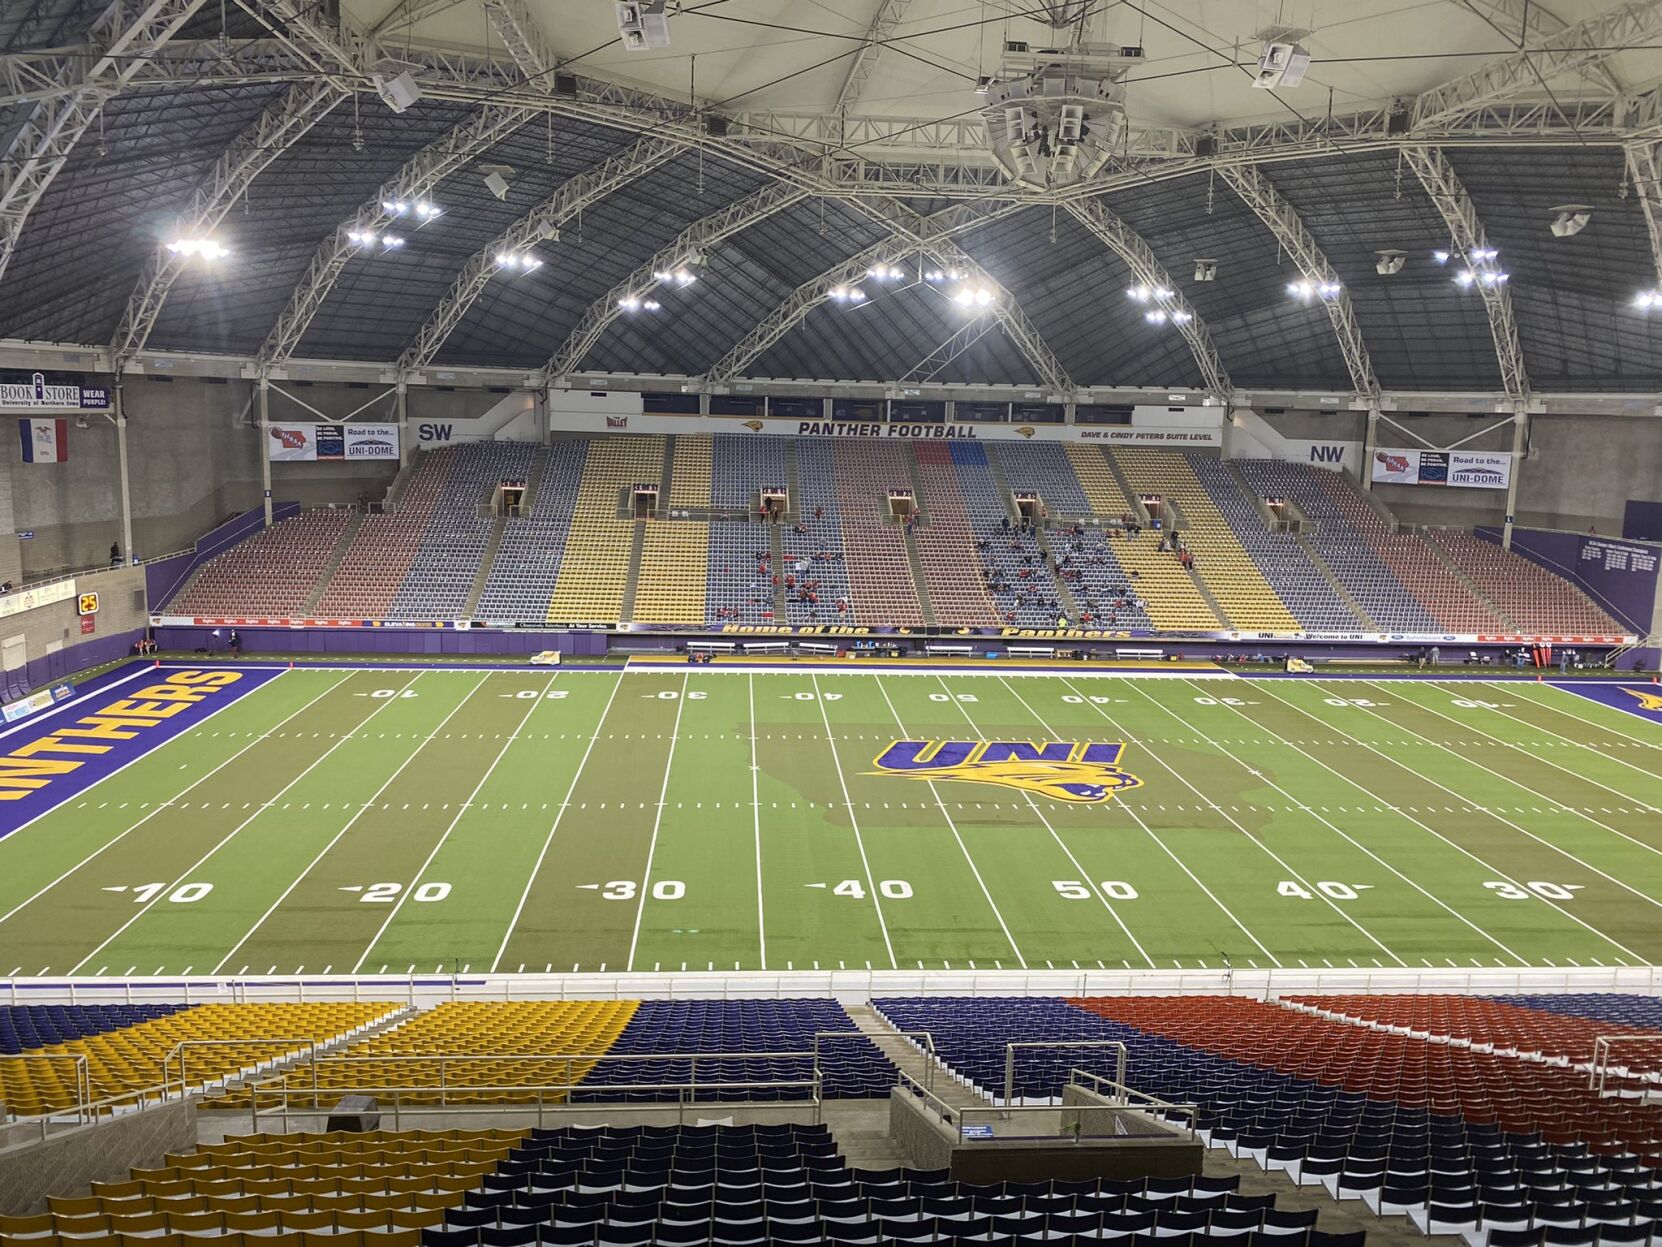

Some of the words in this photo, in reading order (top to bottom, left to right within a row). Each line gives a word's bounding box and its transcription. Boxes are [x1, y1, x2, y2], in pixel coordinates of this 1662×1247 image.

[1, 386, 33, 400] BOOK
[46, 387, 79, 401] STORE
[83, 390, 105, 398] WEAR
[419, 424, 452, 441] SW
[799, 422, 882, 436] PANTHER
[888, 424, 977, 439] FOOTBALL
[349, 446, 394, 455] UNI-DOME
[1310, 446, 1344, 462] NW
[1453, 456, 1473, 464] Road
[1452, 473, 1504, 484] UNI-DOME
[82, 595, 97, 612] 25
[721, 624, 793, 634] Home
[798, 625, 825, 634] of
[829, 625, 870, 635] the
[1000, 628, 1131, 639] Panthers
[516, 690, 570, 699] 20
[658, 690, 708, 700] 30
[794, 692, 843, 701] 40
[929, 693, 978, 702] 50
[1061, 694, 1111, 703] 40
[0, 671, 243, 800] NTHERS
[872, 740, 1127, 771] UNI
[132, 882, 214, 903] 10
[359, 882, 452, 902] 20
[602, 880, 686, 900] 30
[832, 879, 914, 900] 40
[1051, 879, 1139, 900] 50
[1276, 879, 1359, 900] 40
[1482, 879, 1575, 900] 30
